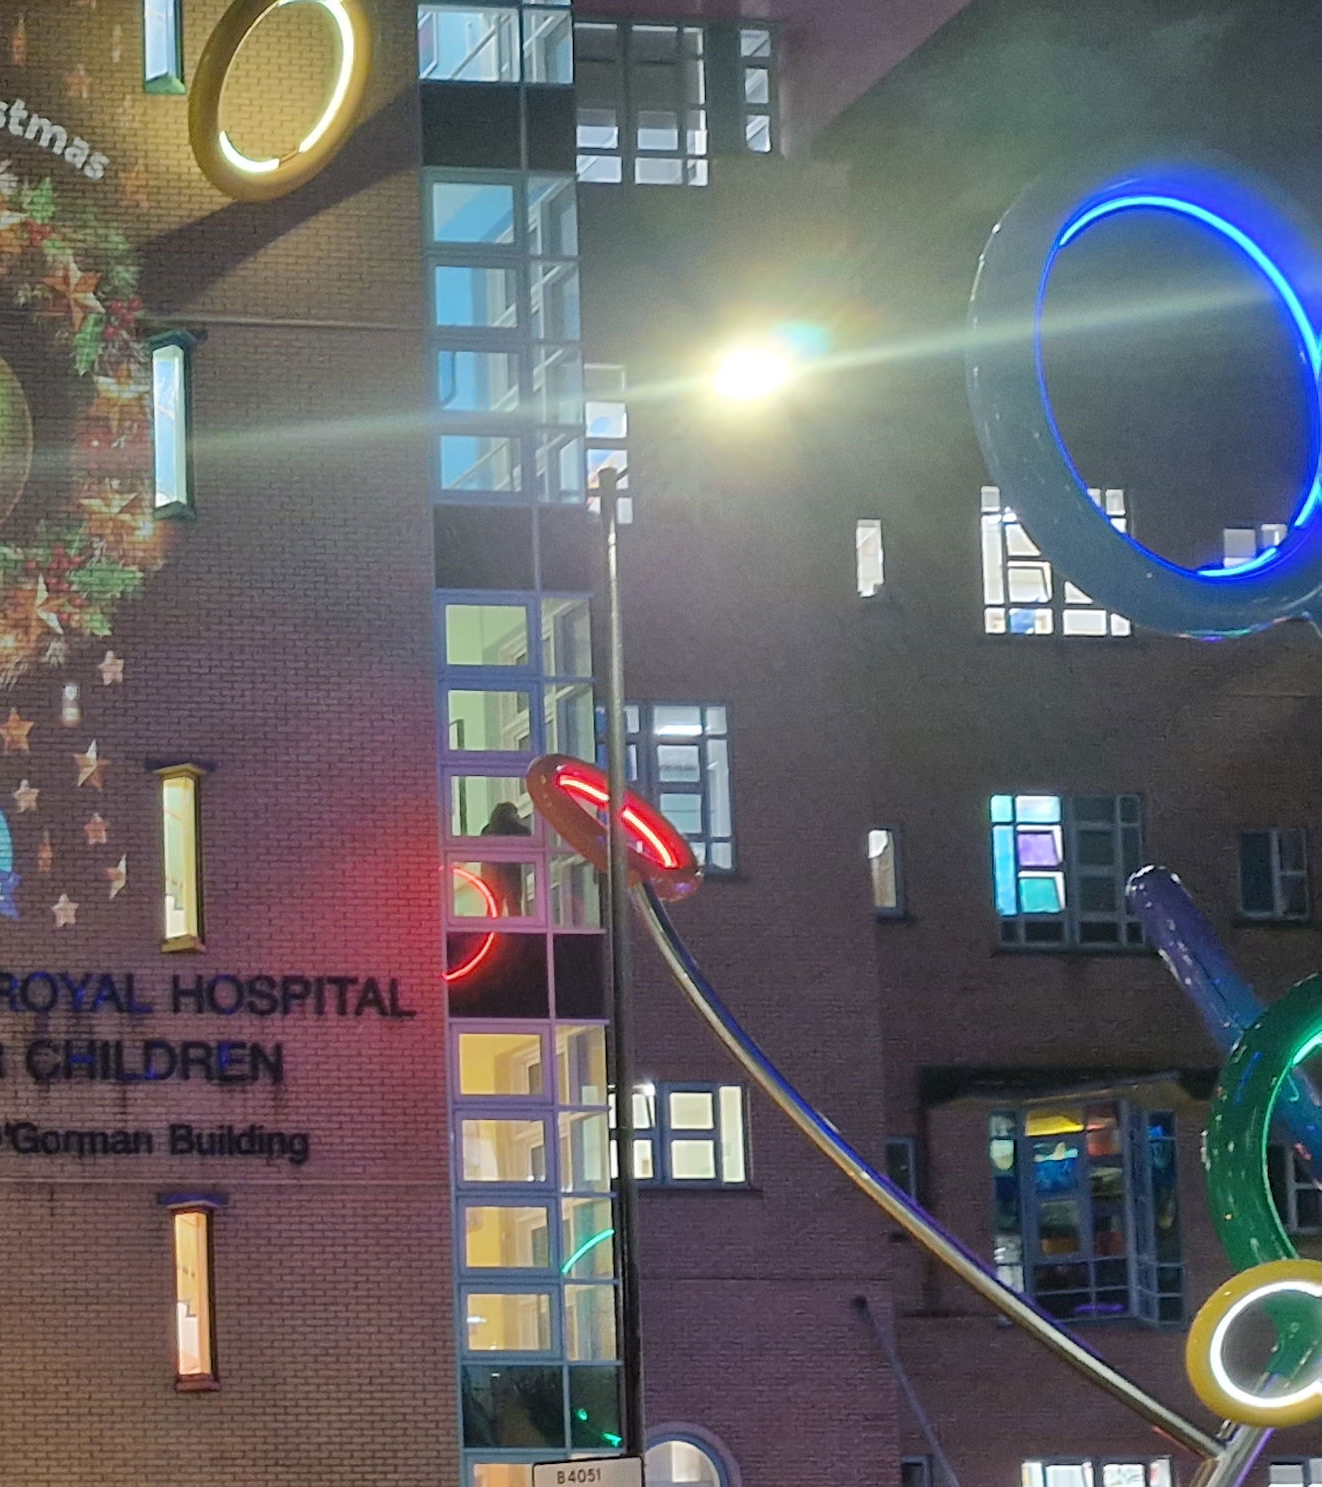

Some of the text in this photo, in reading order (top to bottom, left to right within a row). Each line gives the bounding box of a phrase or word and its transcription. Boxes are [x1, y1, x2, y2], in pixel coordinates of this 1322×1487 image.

[172, 973, 416, 1018] HOSPITAL
[25, 1038, 284, 1084] CHILDREN
[169, 1123, 309, 1166] Building
